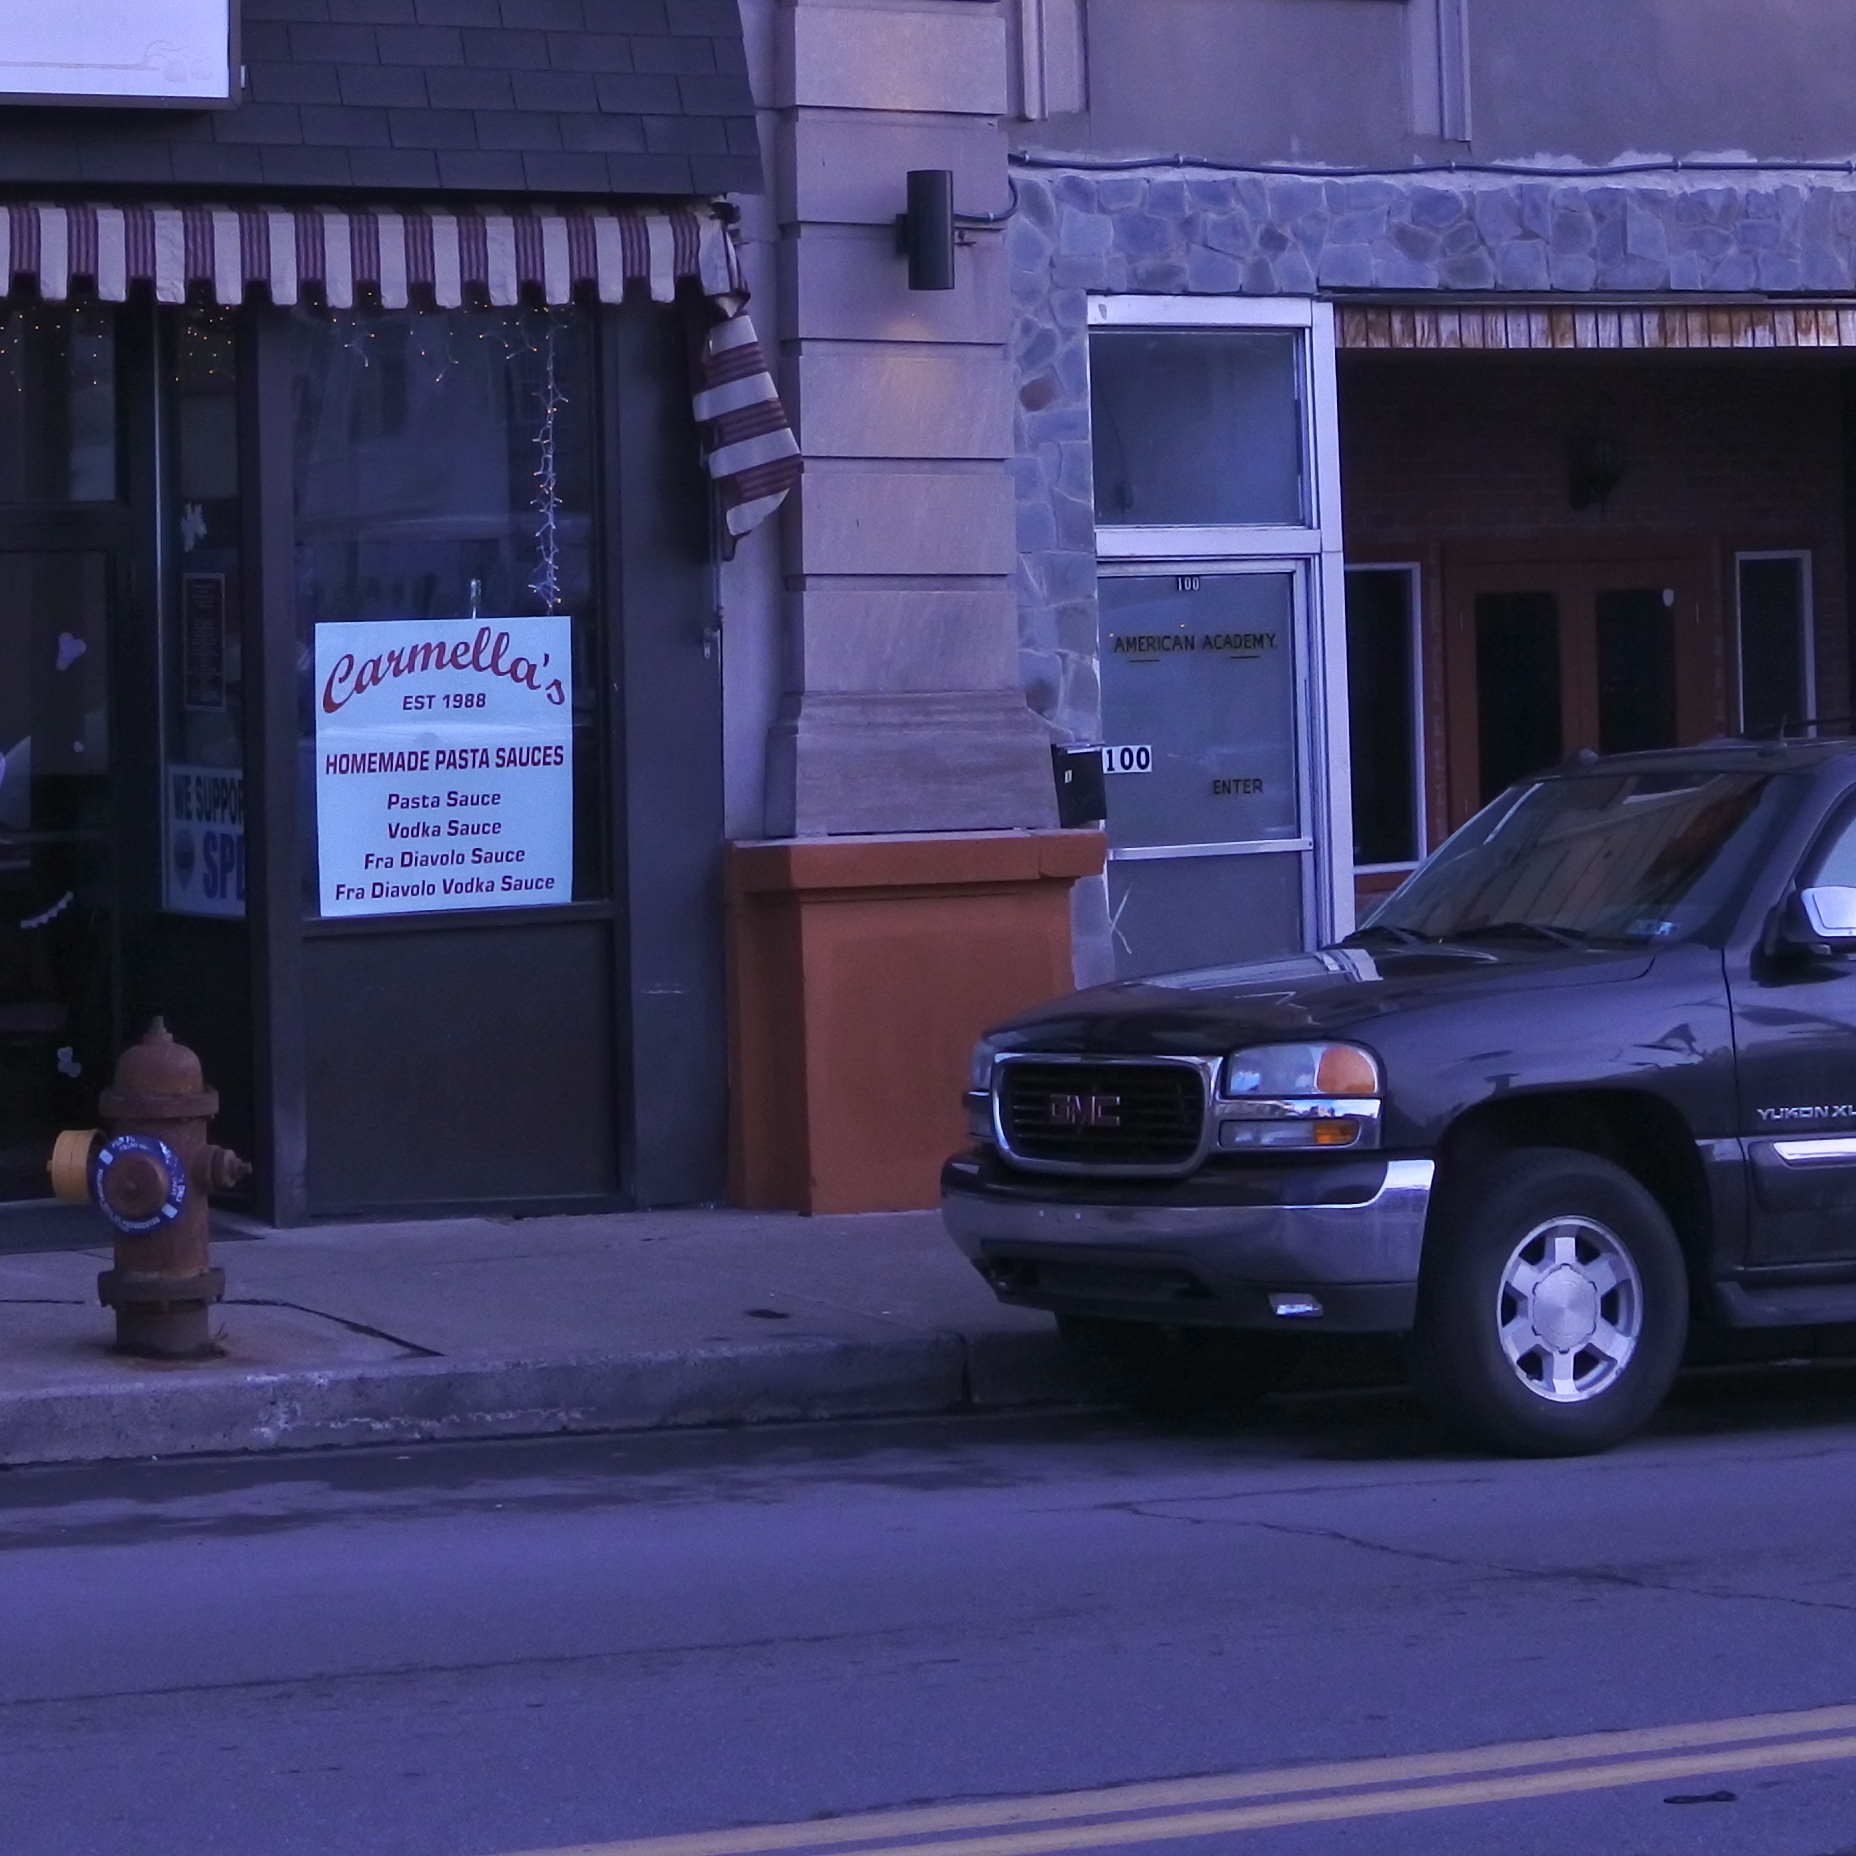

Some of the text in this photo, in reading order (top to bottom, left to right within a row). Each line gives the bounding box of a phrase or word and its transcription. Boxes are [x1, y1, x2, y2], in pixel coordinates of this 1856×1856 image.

[1177, 576, 1200, 592] 100
[1114, 635, 1195, 653] AMERICAN
[322, 626, 565, 713] Carmella's
[402, 693, 486, 711] EST 1988
[325, 745, 564, 775] HOMEMADE PASTA SAUCES
[1105, 746, 1151, 772] 100
[1212, 778, 1264, 795] ENTER
[172, 773, 192, 821] WE
[387, 791, 501, 810] Pasta Sauce
[387, 820, 502, 839] Vodka Sauce
[364, 848, 525, 870] Fra Diavolo Sauce
[335, 875, 555, 901] Fra Diavolo Vodka Sauce
[1050, 1093, 1121, 1126] GMC
[1757, 1106, 1829, 1120] YUKON
